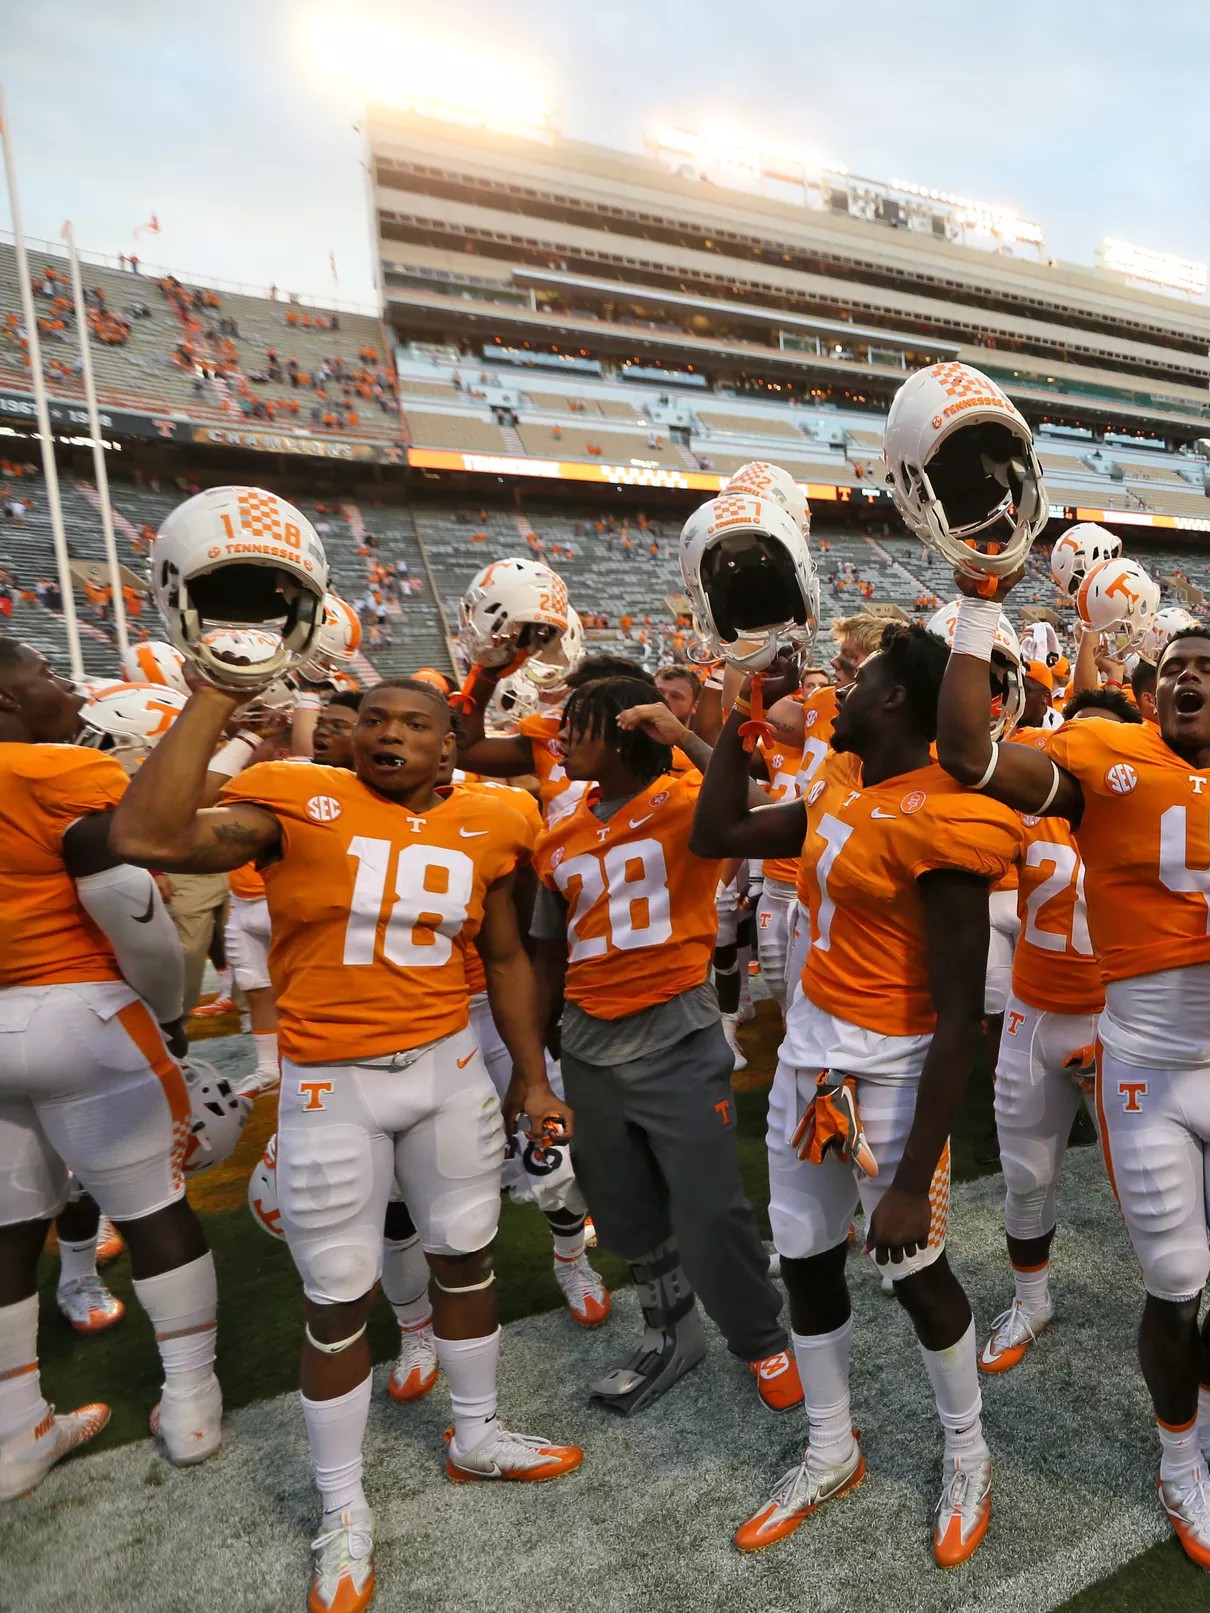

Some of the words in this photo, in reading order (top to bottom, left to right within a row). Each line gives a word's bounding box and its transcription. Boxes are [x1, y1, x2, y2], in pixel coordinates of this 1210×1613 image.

[943, 397, 1004, 417] TENNESSEE
[152, 419, 177, 438] T
[207, 429, 352, 458] CHAMPIONS
[838, 486, 852, 501] T
[226, 543, 301, 564] TENNESSEE
[1105, 573, 1140, 607] T
[1107, 765, 1138, 793] SEC
[1189, 775, 1207, 794] T
[308, 797, 341, 822] SEC
[842, 790, 862, 807] T
[406, 816, 427, 833] T
[596, 827, 611, 843] T
[811, 813, 854, 952] 7
[342, 835, 474, 967] 18
[553, 838, 673, 964] 28
[760, 912, 773, 929] T
[1005, 1010, 1025, 1037] T
[297, 1079, 335, 1113] T
[1117, 1080, 1149, 1114] T
[711, 1098, 733, 1127] T
